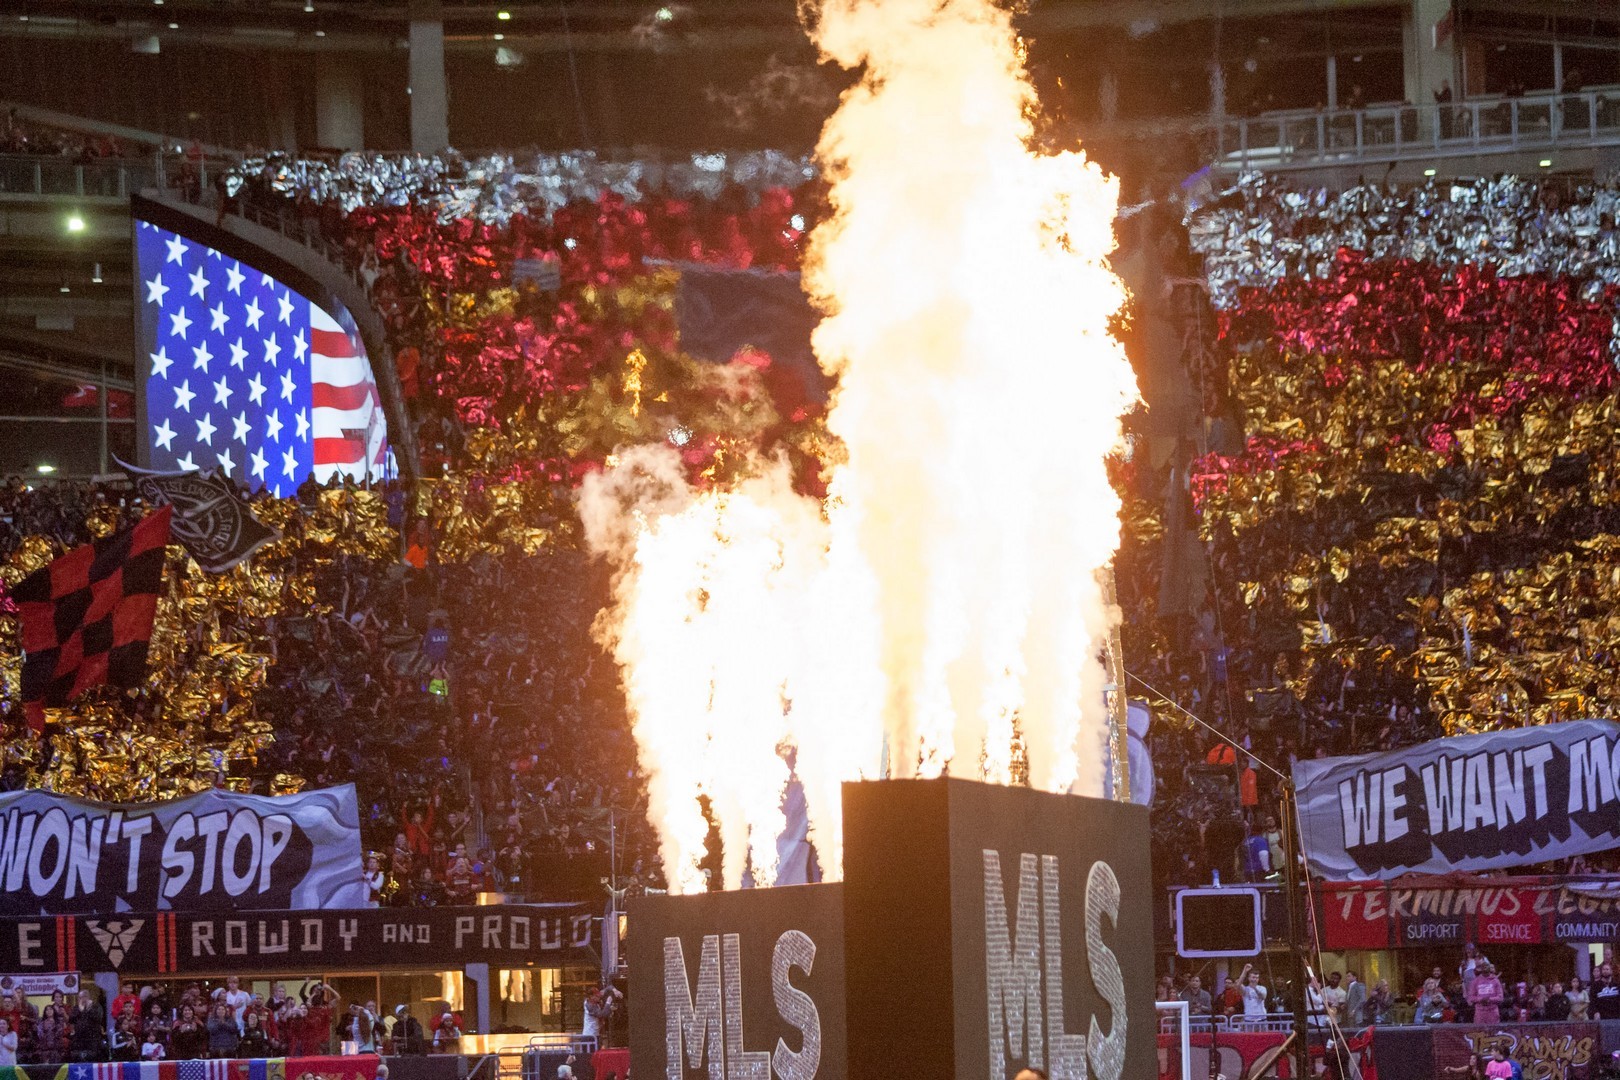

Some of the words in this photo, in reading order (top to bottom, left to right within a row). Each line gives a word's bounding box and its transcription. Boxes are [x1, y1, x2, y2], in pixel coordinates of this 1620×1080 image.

[1338, 765, 1409, 849] WE
[1421, 743, 1554, 836] WANT
[0, 808, 153, 899] WON'T
[161, 808, 293, 898] STOP
[18, 923, 44, 966] E
[191, 917, 358, 956] ROWDY
[382, 923, 431, 944] AND
[455, 914, 593, 949] PROUD
[983, 849, 1127, 1080] MLS
[1407, 923, 1460, 939] SUPPORT
[1487, 923, 1532, 939] SERVICE
[1556, 922, 1618, 938] COMMUNITY
[664, 930, 821, 1080] MLS
